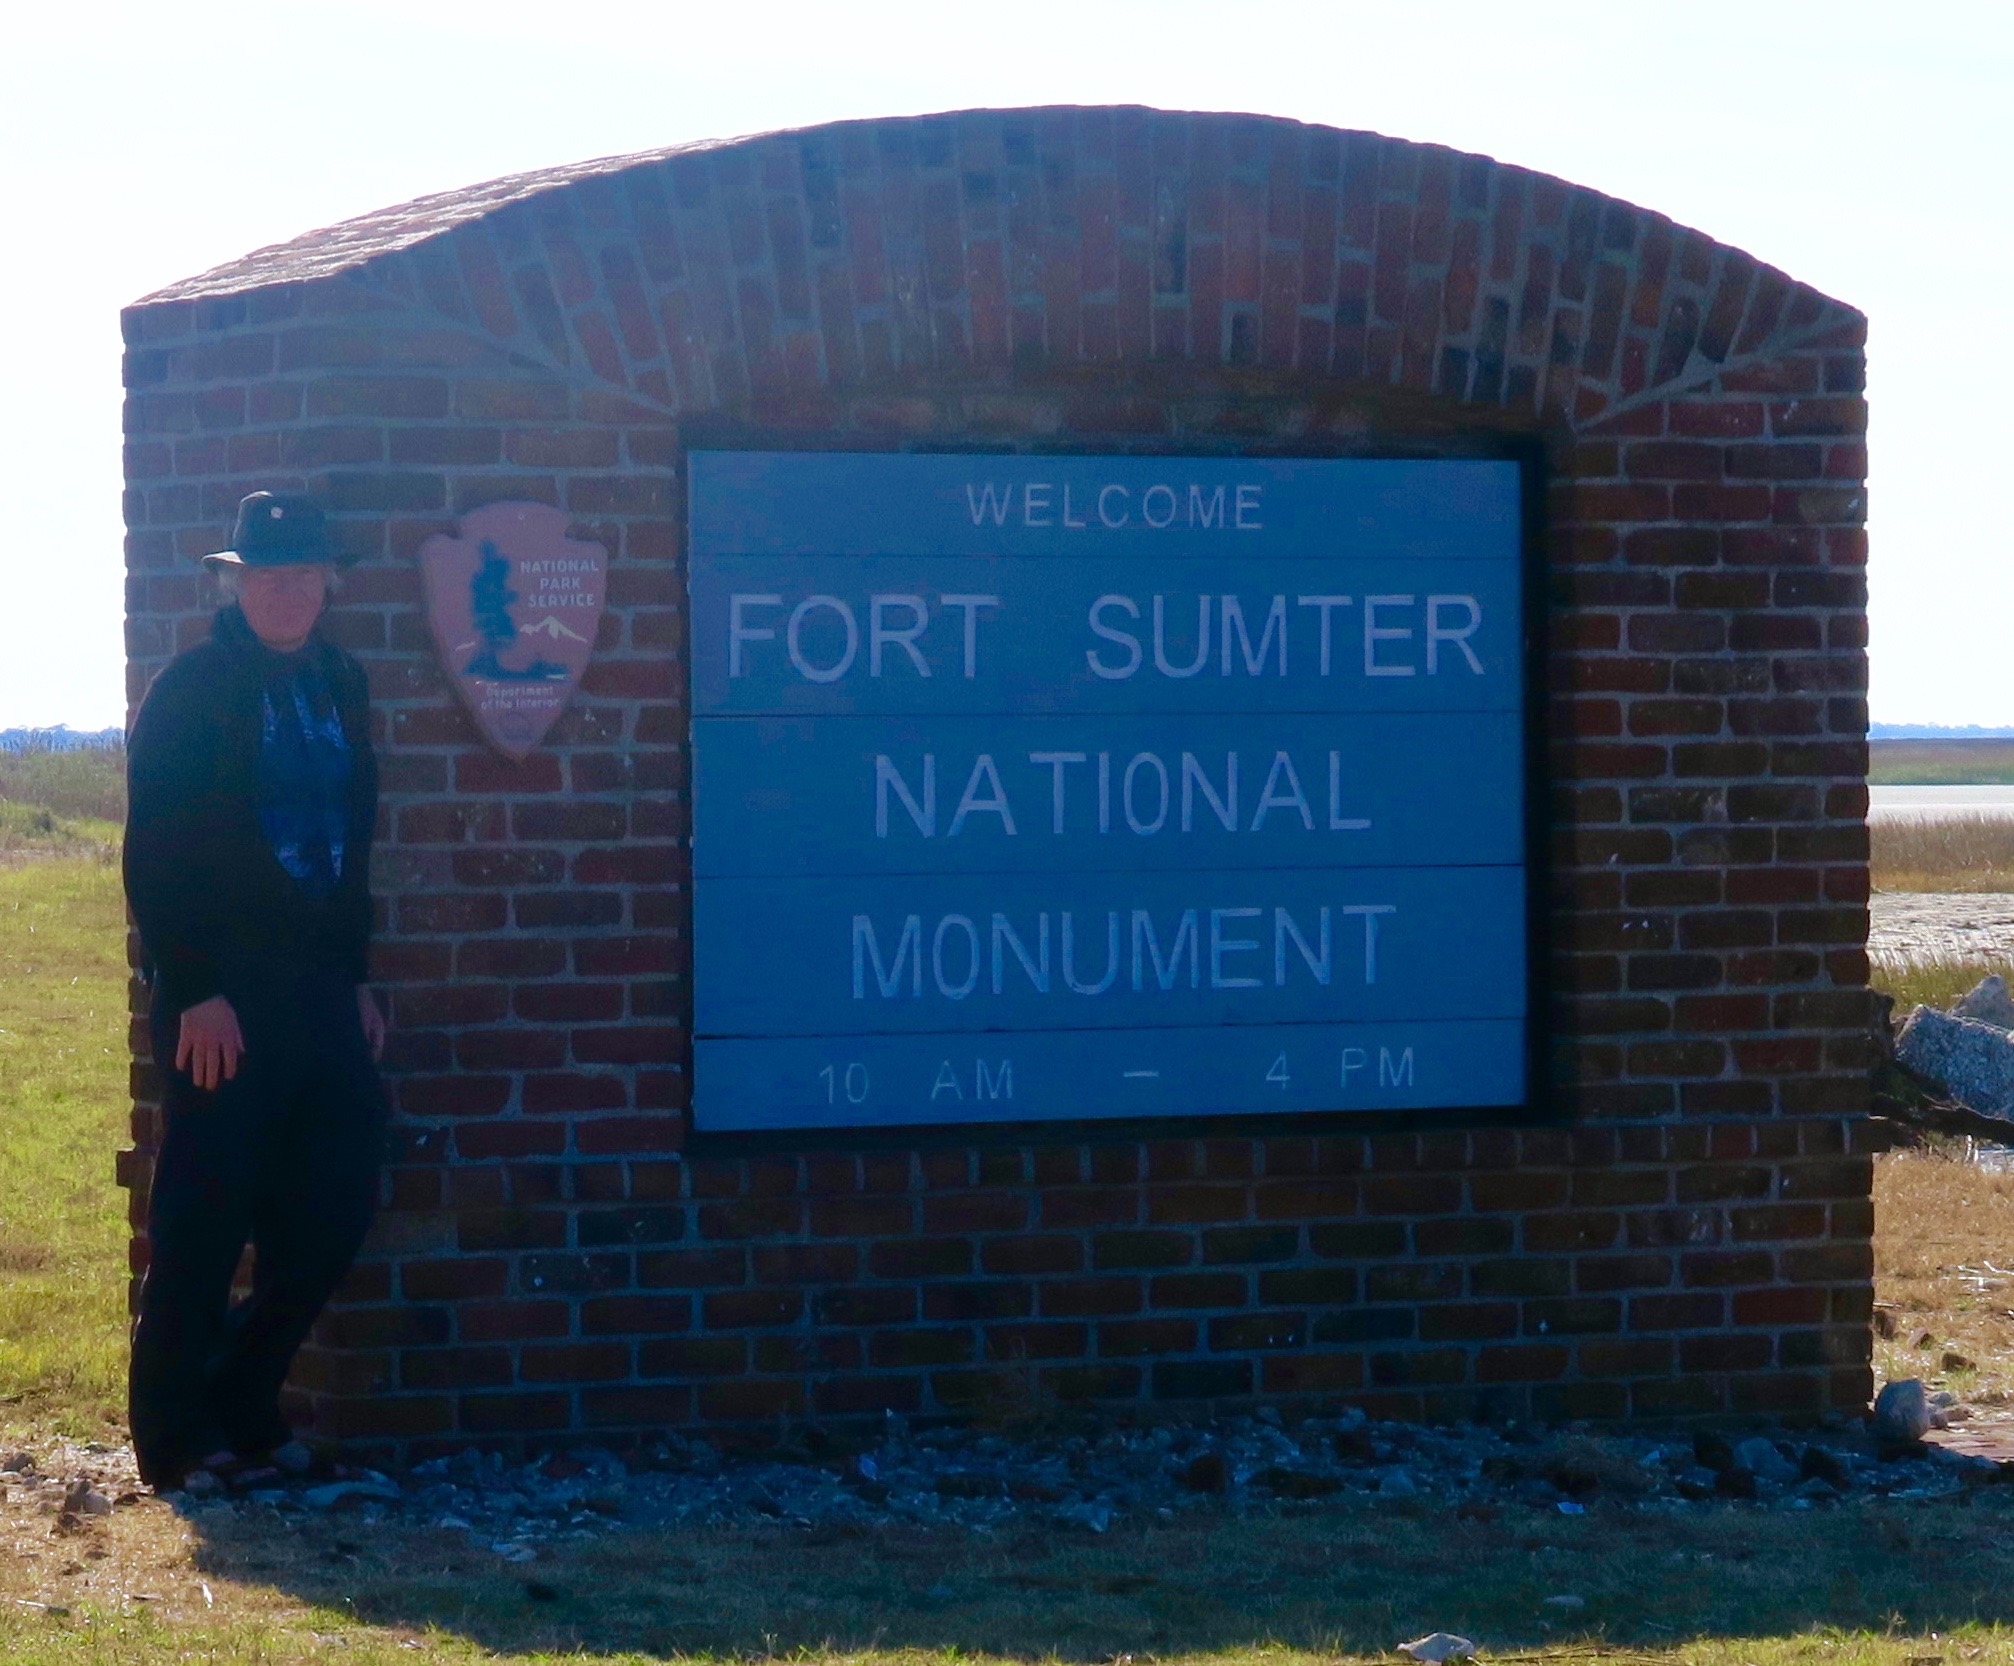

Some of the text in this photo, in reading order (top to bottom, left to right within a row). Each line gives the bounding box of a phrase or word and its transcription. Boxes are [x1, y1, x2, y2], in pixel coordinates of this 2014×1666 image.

[965, 482, 1264, 529] WELCOME
[520, 559, 599, 573] NATIONAL
[540, 577, 581, 590] PARK
[529, 593, 595, 607] SERVICE
[728, 592, 1486, 683] FORT SUMTER
[486, 686, 554, 698] Department
[874, 749, 1373, 838] NATIONAL
[851, 904, 1397, 1000] MONUMENT
[818, 1063, 869, 1105] 10
[930, 1059, 1014, 1101] AM
[1265, 1052, 1291, 1088] 4
[1340, 1046, 1415, 1088] PM
